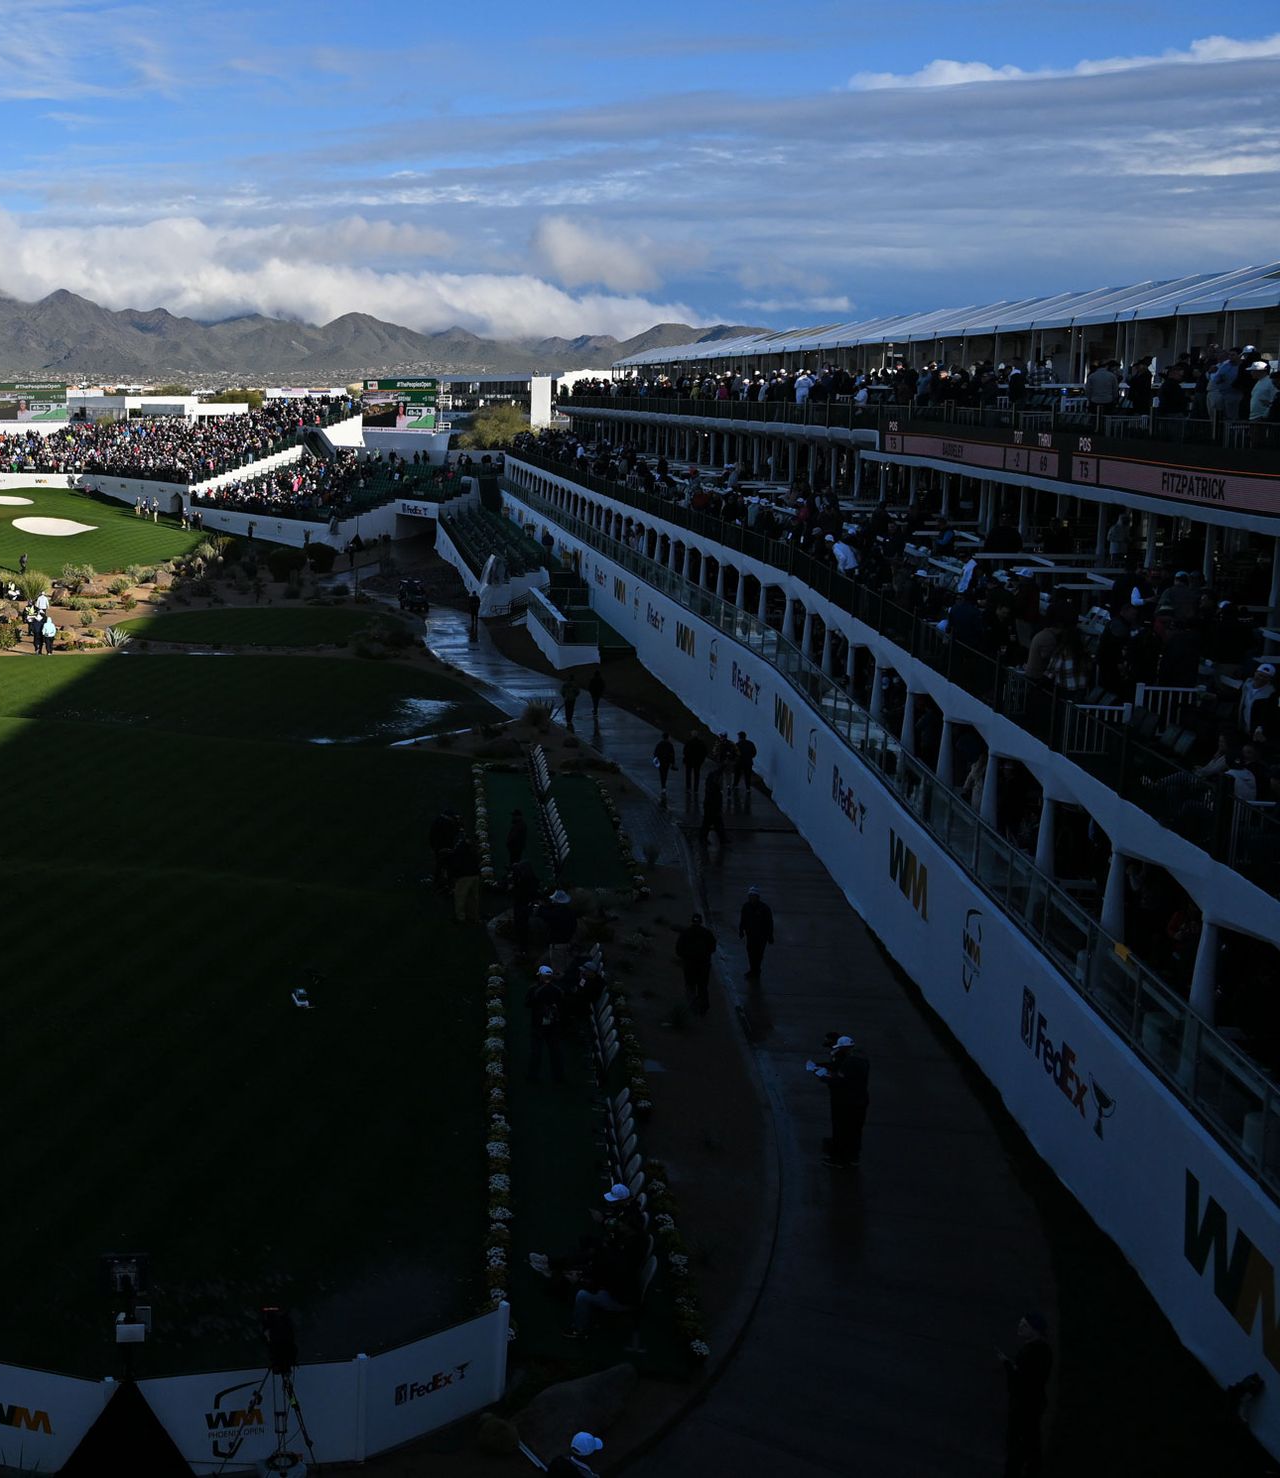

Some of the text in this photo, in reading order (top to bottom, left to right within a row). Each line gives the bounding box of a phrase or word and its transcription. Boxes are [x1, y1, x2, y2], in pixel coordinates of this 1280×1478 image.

[888, 421, 899, 433] POS
[890, 437, 897, 450] T5
[1013, 431, 1053, 448] TOT THRU
[1078, 437, 1093, 453] POS
[1079, 460, 1226, 501] T5 FITZPATRICK
[676, 621, 696, 658] WM
[736, 669, 754, 702] FedEx
[775, 693, 793, 749] WM
[837, 777, 857, 828] FedEx
[889, 827, 928, 922] WM
[962, 928, 981, 967] WM
[1035, 1012, 1088, 1119] FedEx
[1184, 1167, 1280, 1375] WM
[409, 1374, 452, 1402] FedEx
[205, 1408, 264, 1431] WM
[208, 1426, 265, 1439] PHOENIX OPEN
